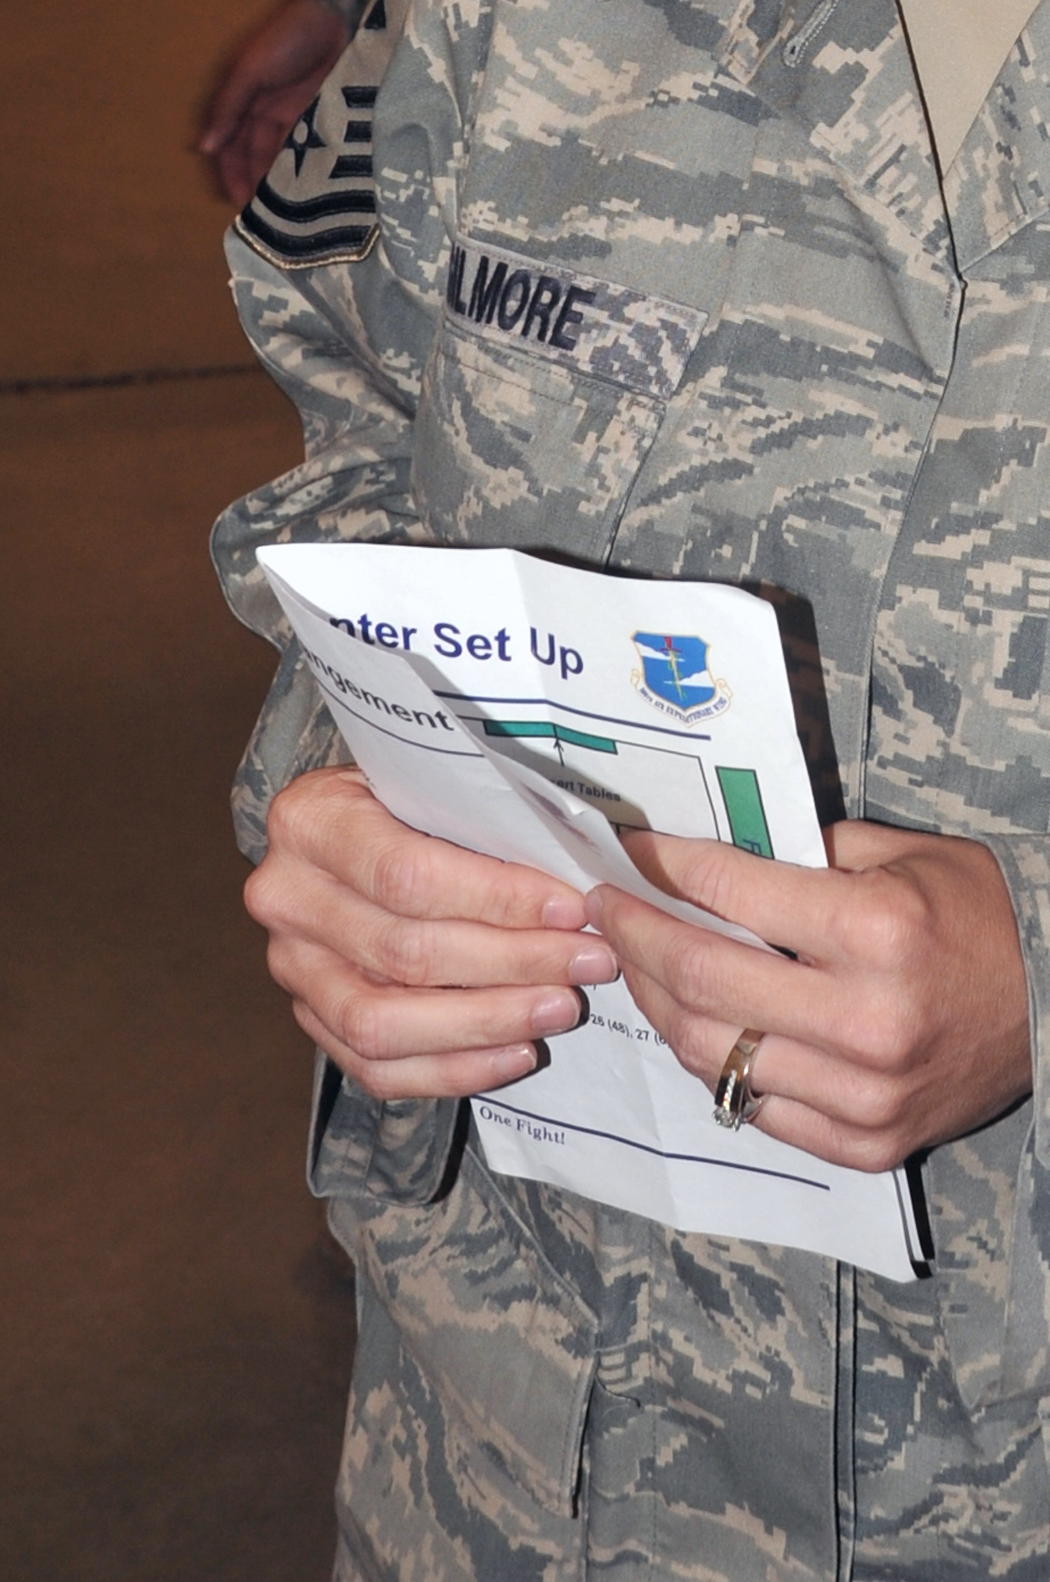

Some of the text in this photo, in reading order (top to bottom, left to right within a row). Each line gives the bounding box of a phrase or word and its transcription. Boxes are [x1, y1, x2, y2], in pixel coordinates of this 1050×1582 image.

[434, 622, 512, 662] Set
[530, 626, 583, 680] Up
[550, 779, 621, 802] ert Tables
[635, 1028, 649, 1041] 27
[479, 1106, 565, 1145] One Fight!
